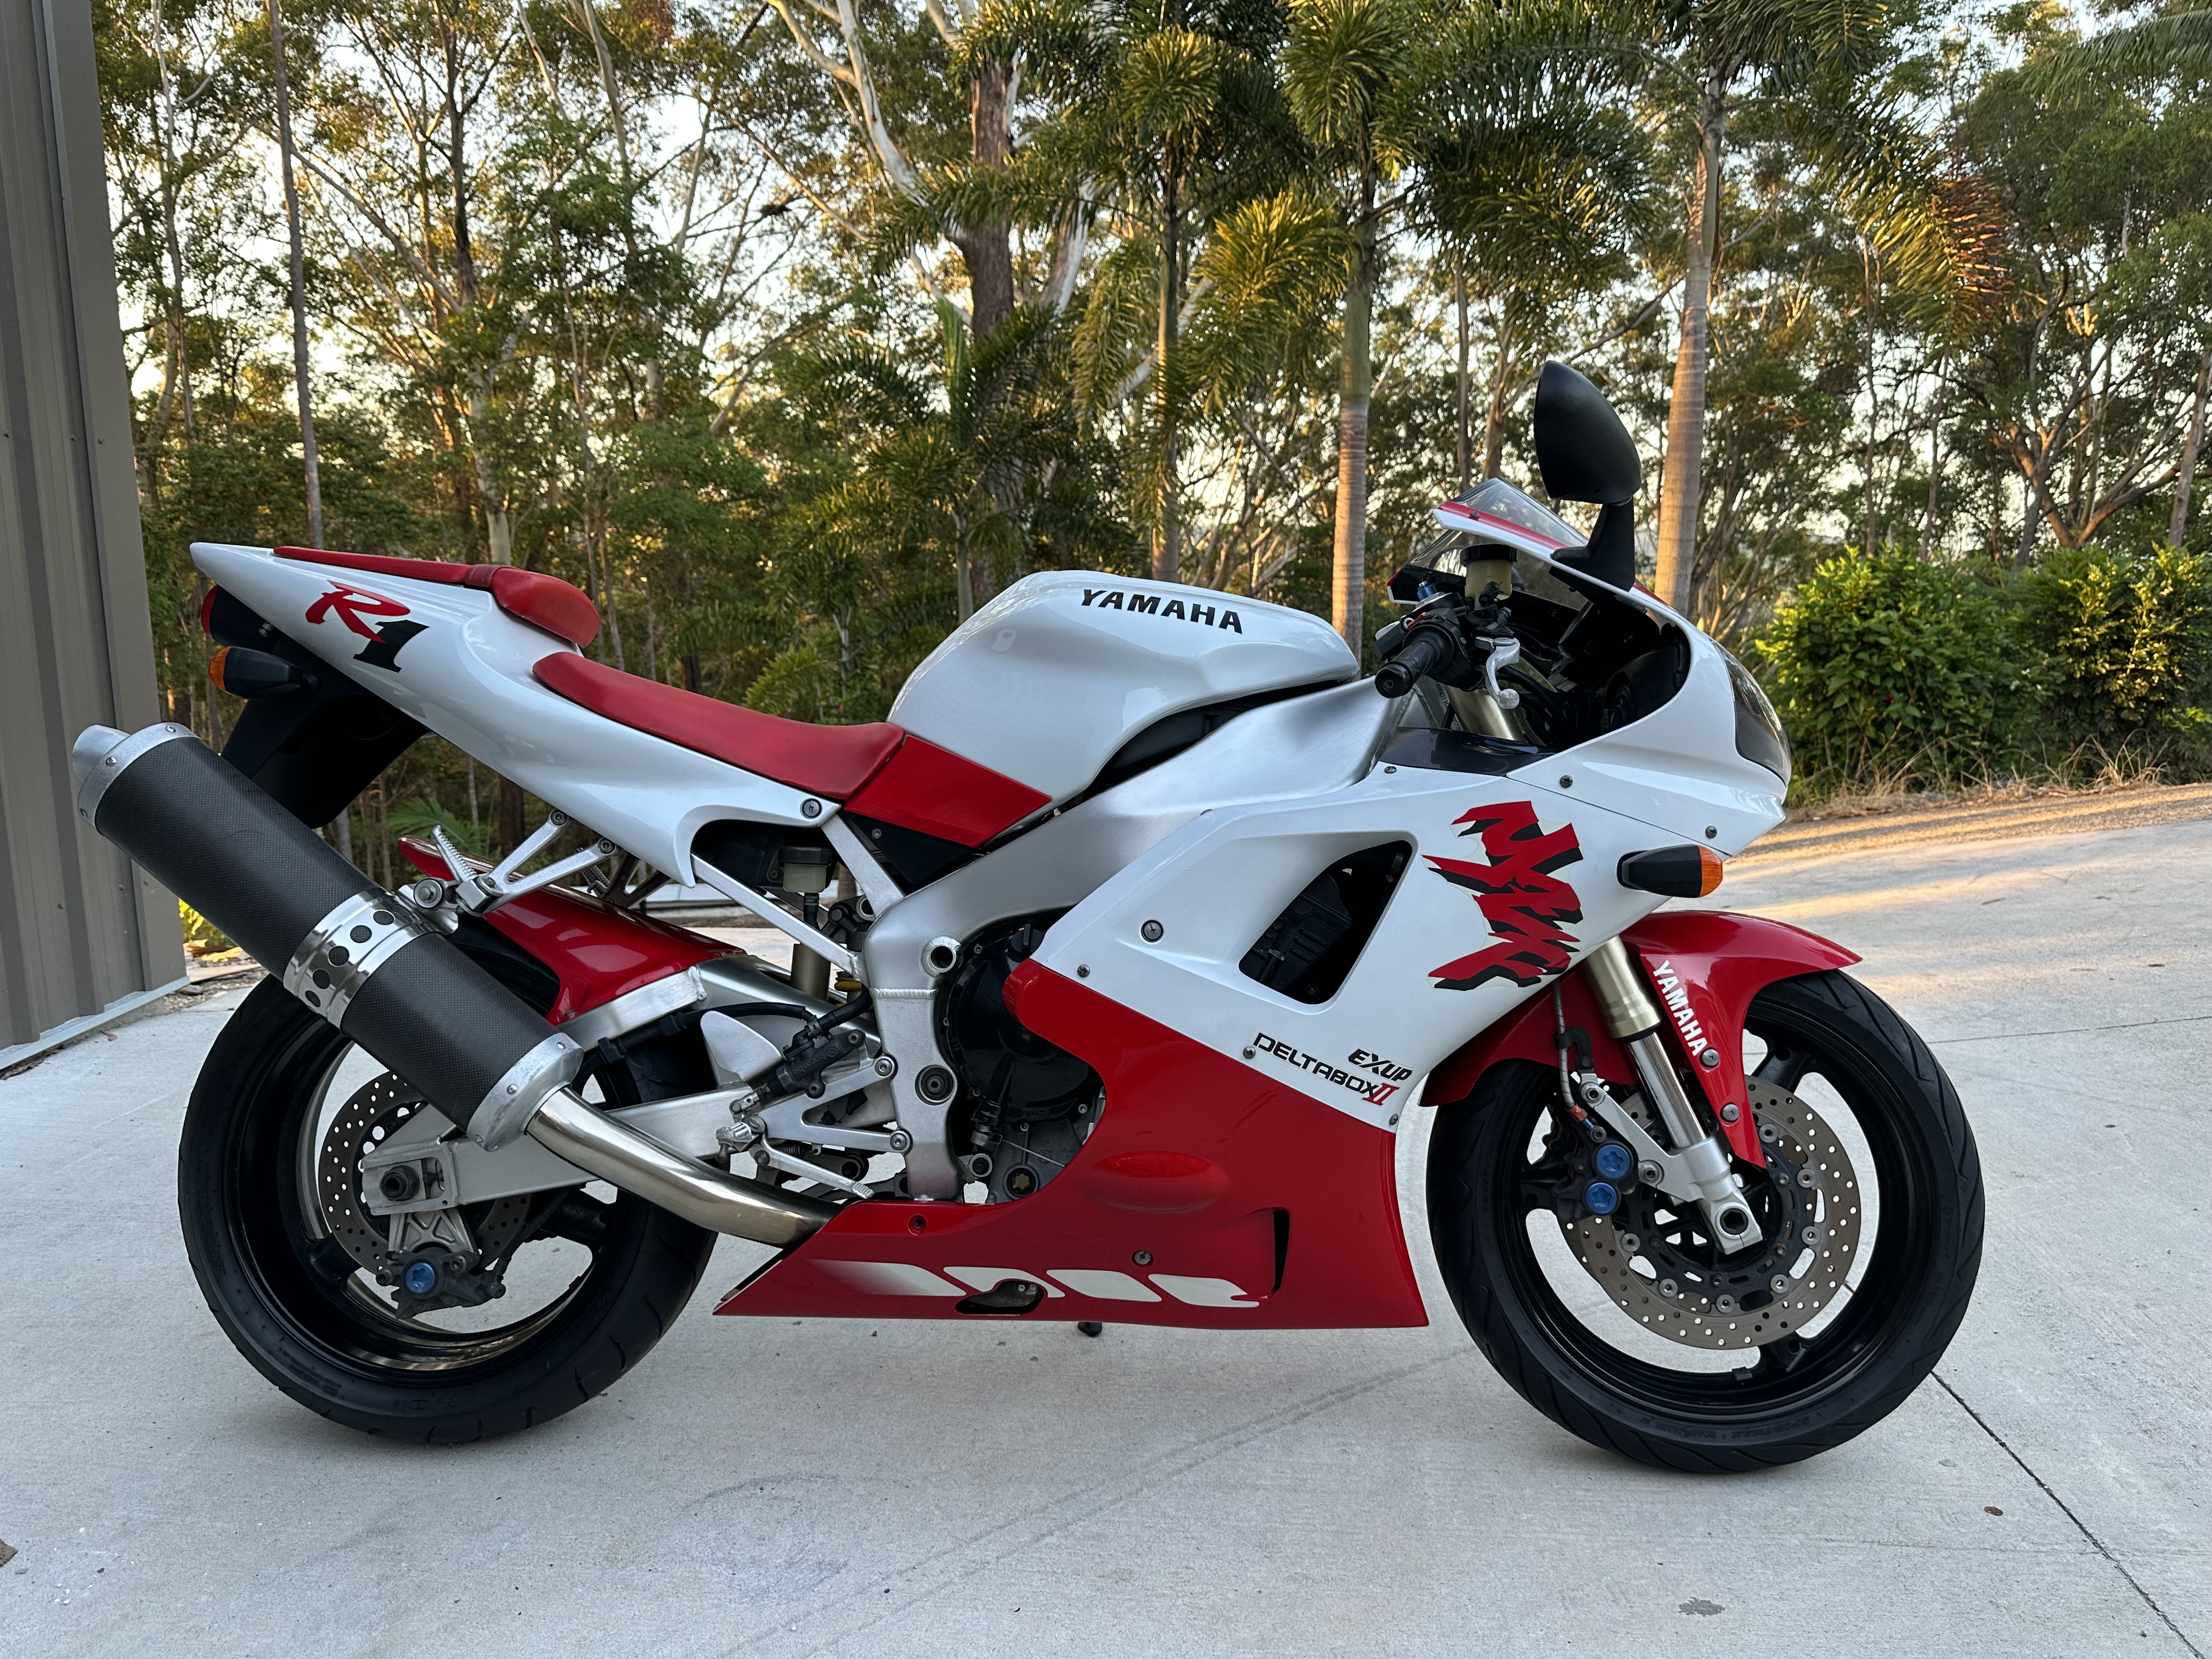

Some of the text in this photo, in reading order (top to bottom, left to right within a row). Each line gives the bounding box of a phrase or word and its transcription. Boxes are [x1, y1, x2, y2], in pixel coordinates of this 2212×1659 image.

[305, 579, 430, 673] R1
[1081, 589, 1243, 635] YAMAHA
[1652, 959, 1708, 1057] YAMAHA
[1347, 1048, 1413, 1081] EXUP
